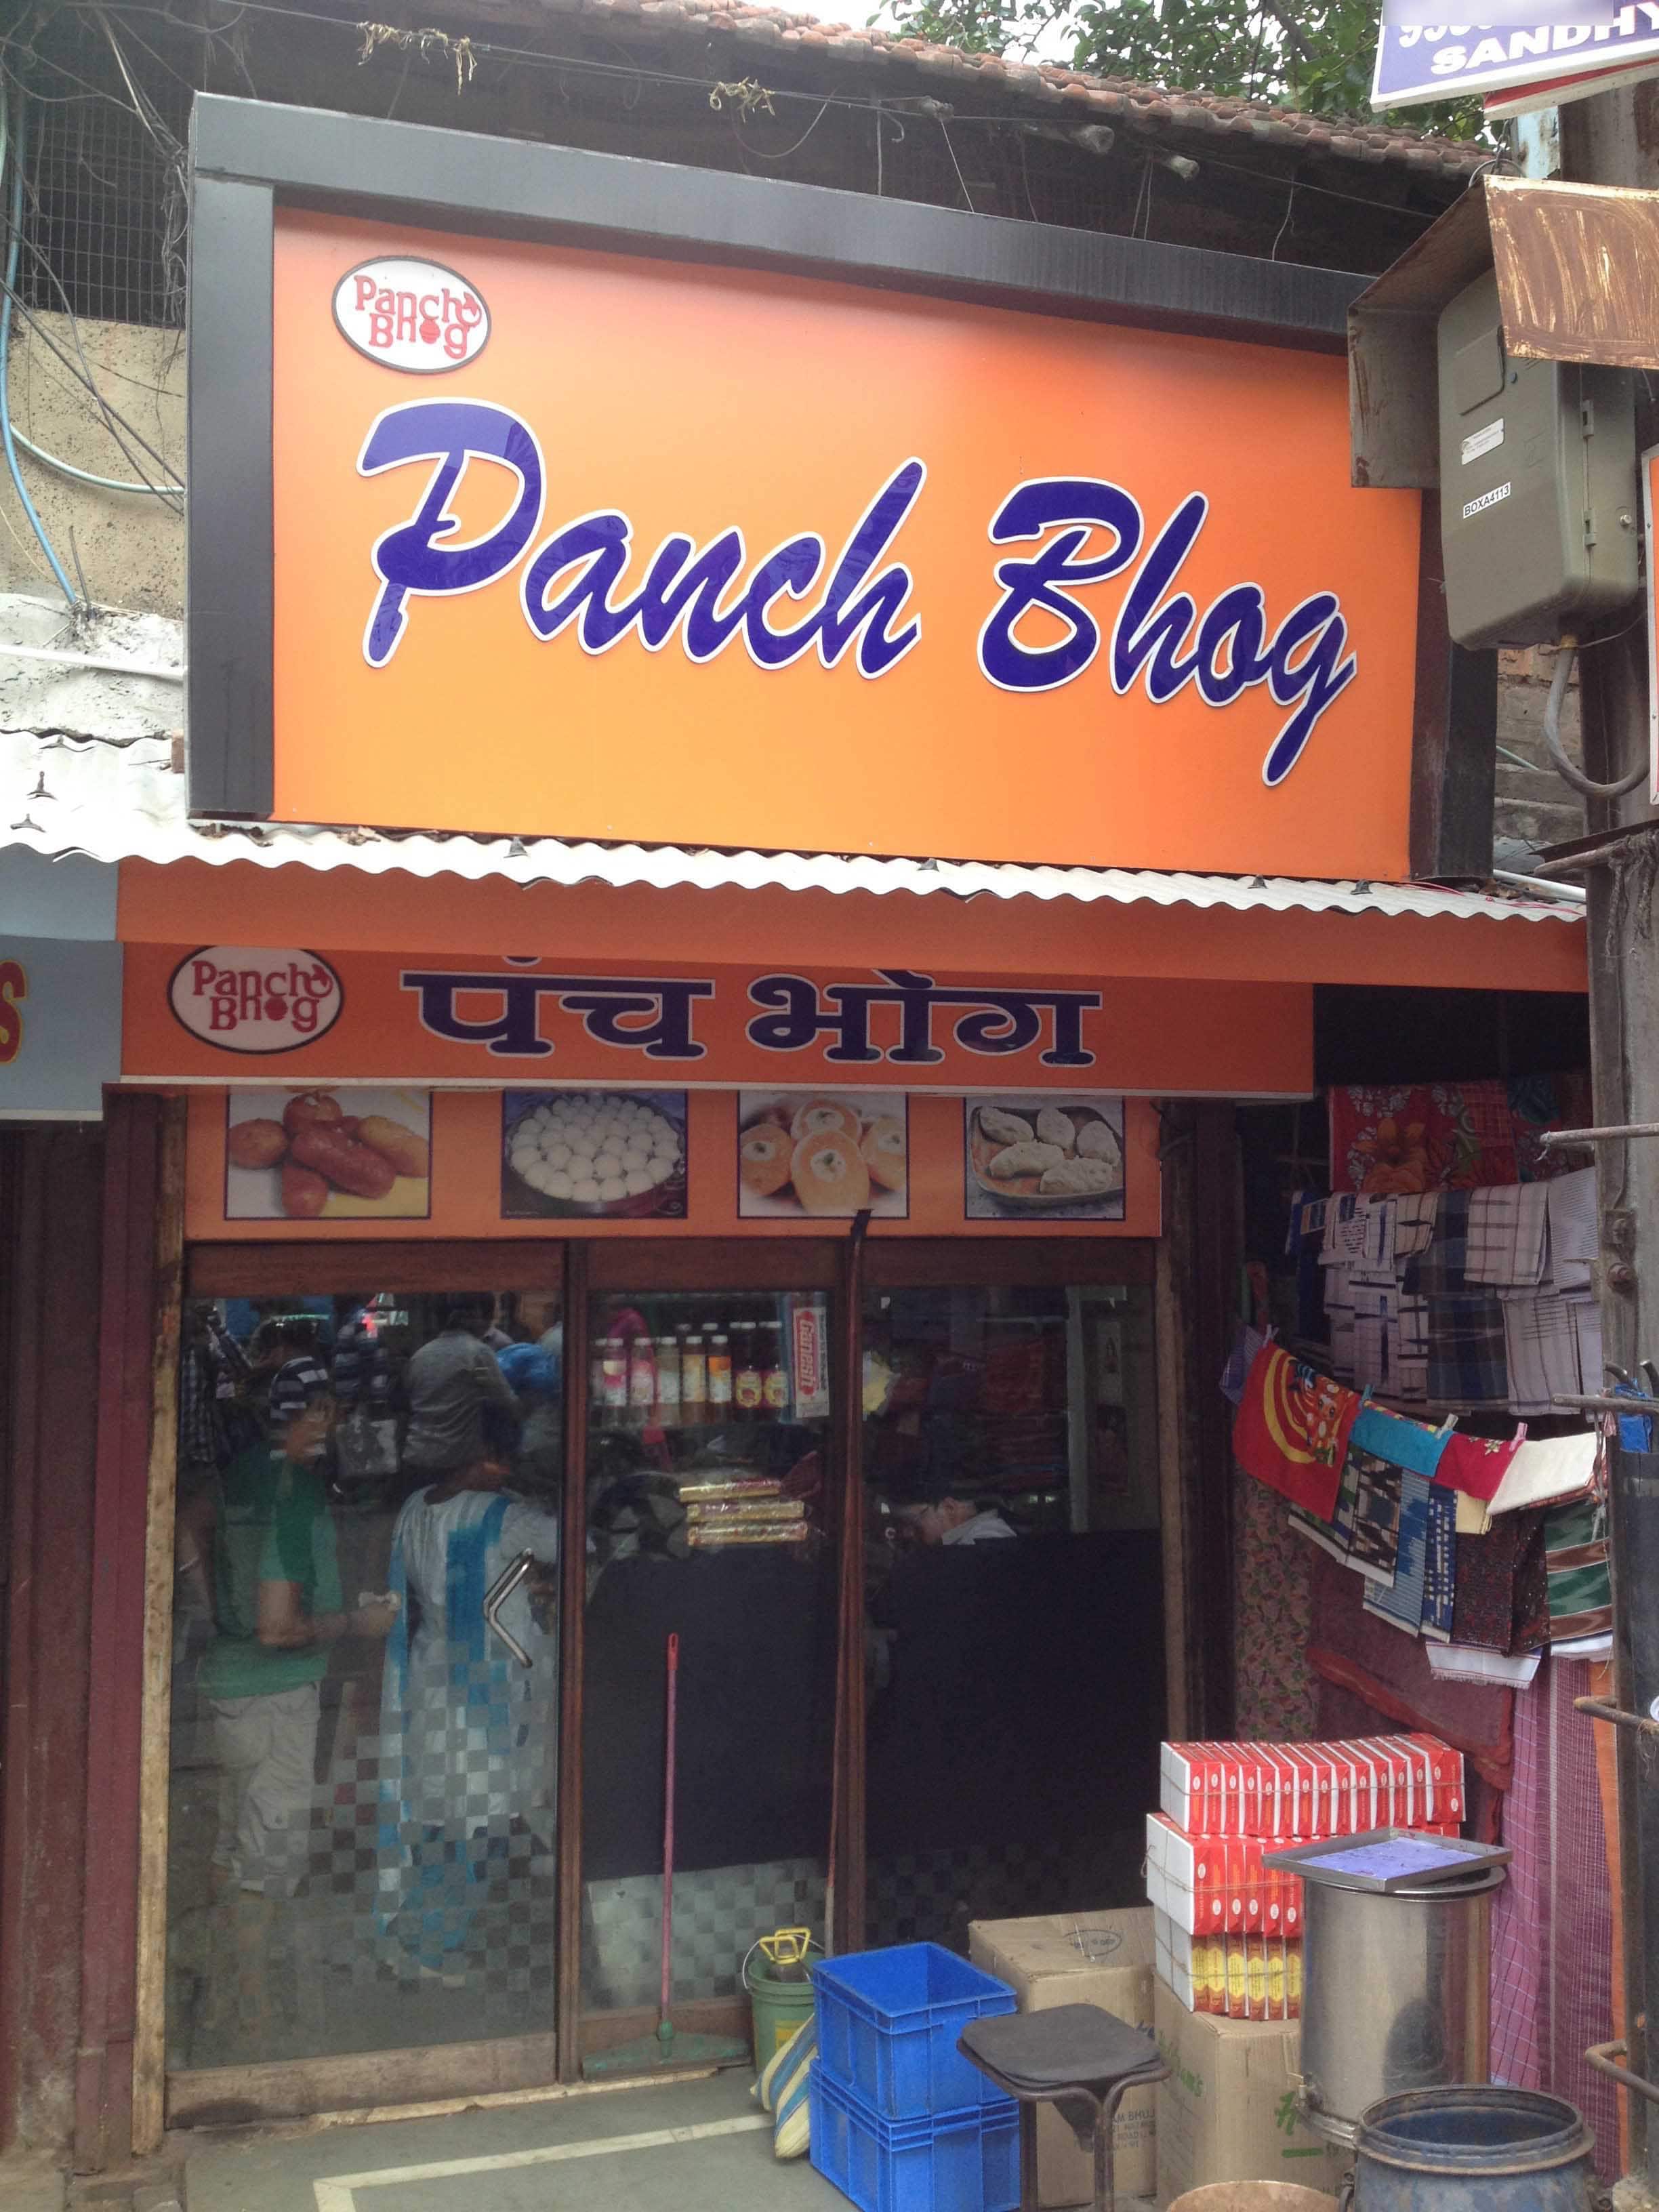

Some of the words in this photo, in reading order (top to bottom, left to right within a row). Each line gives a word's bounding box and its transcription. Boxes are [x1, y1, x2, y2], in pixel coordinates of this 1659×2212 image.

[354, 275, 482, 327] Panch
[1464, 485, 1510, 517] BOXA4113
[356, 396, 927, 680] Panch
[977, 476, 1357, 786] Bhog
[192, 960, 333, 998] Panch
